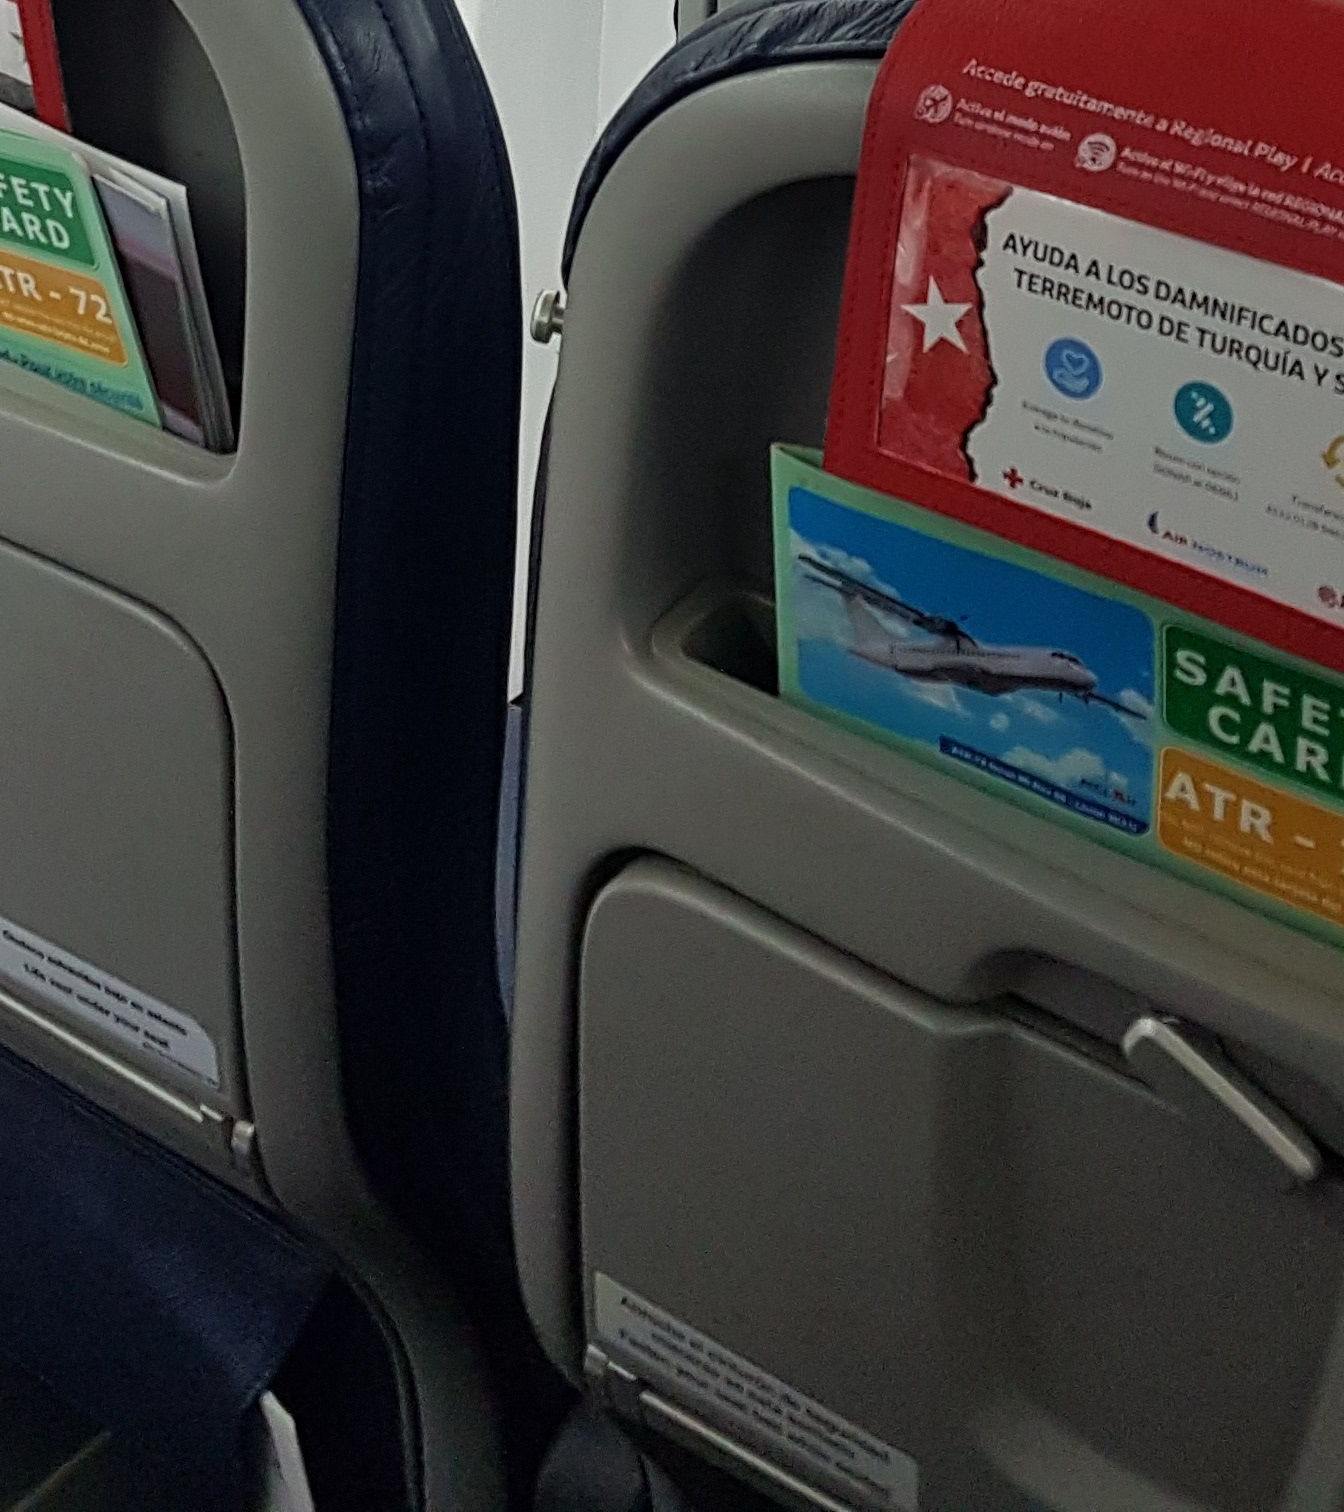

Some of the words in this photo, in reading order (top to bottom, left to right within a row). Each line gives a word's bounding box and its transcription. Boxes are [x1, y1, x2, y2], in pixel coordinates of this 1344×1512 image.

[962, 56, 1026, 90] Accede
[1023, 76, 1155, 130] gratuitamente
[1168, 117, 1252, 160] Regional
[1252, 140, 1300, 175] Play
[1002, 231, 1082, 273] AYUDA
[1085, 257, 1103, 280] A
[1105, 264, 1151, 296] LOS
[68, 287, 112, 324] 72
[1010, 268, 1154, 331] TERREMOTO
[1156, 315, 1190, 343] DE
[1191, 320, 1308, 383] TURQUÍA
[1311, 365, 1328, 386] Y
[1165, 772, 1274, 844] ATR
